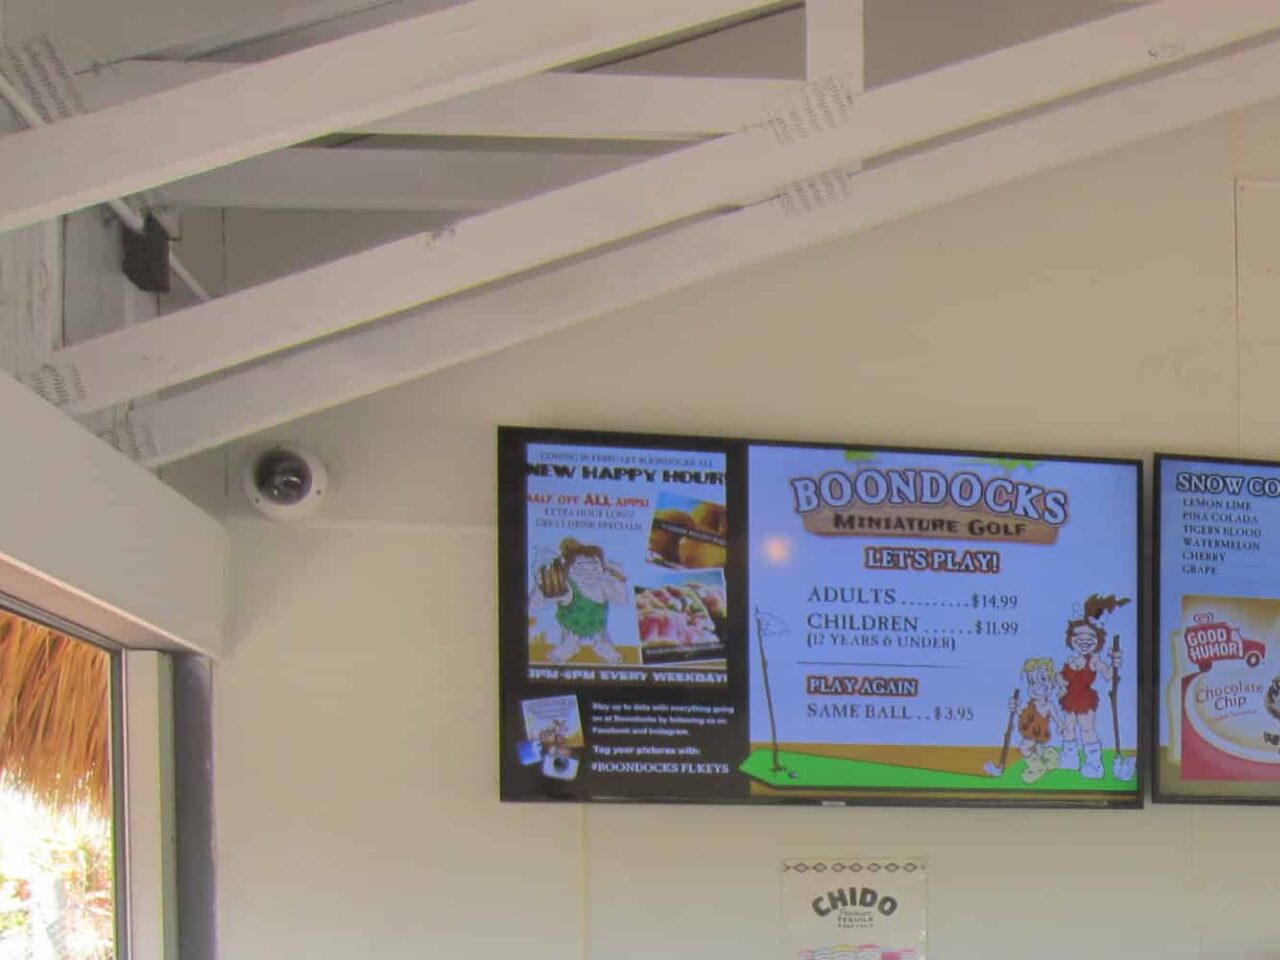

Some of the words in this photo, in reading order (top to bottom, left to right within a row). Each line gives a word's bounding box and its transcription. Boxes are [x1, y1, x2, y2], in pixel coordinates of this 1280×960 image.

[581, 466, 657, 483] HAPPY
[1177, 472, 1244, 493] SNOW
[584, 494, 612, 507] ALL
[791, 469, 1068, 525] BOONDOCKS
[1183, 498, 1222, 510] LEMON
[1226, 500, 1252, 511] LIME
[833, 513, 958, 533] MINIATURE
[968, 519, 1026, 537] GOLF
[1211, 512, 1258, 524] COLADA
[1223, 526, 1262, 538] BLOOD
[1184, 538, 1260, 550] WATERMELON
[865, 547, 928, 570] LET'S
[932, 550, 1000, 572] PLAY!
[1182, 552, 1226, 563] CHERRY
[1182, 565, 1218, 576] GRAPE
[808, 587, 896, 604] ADULTS
[807, 612, 918, 632] CHILDREN
[830, 634, 878, 646] YEARS
[897, 636, 956, 651] UNDER)
[1186, 629, 1228, 646] GOOD
[1189, 642, 1240, 660] HUMOR
[807, 676, 858, 694] PLAY
[860, 678, 918, 697] AGAIN
[1195, 680, 1264, 703] Chocolate
[807, 704, 860, 720] SAME
[865, 704, 912, 720] BALL
[1214, 695, 1246, 712] Chip
[636, 746, 676, 757] pictures
[812, 886, 898, 917] CHIDO
